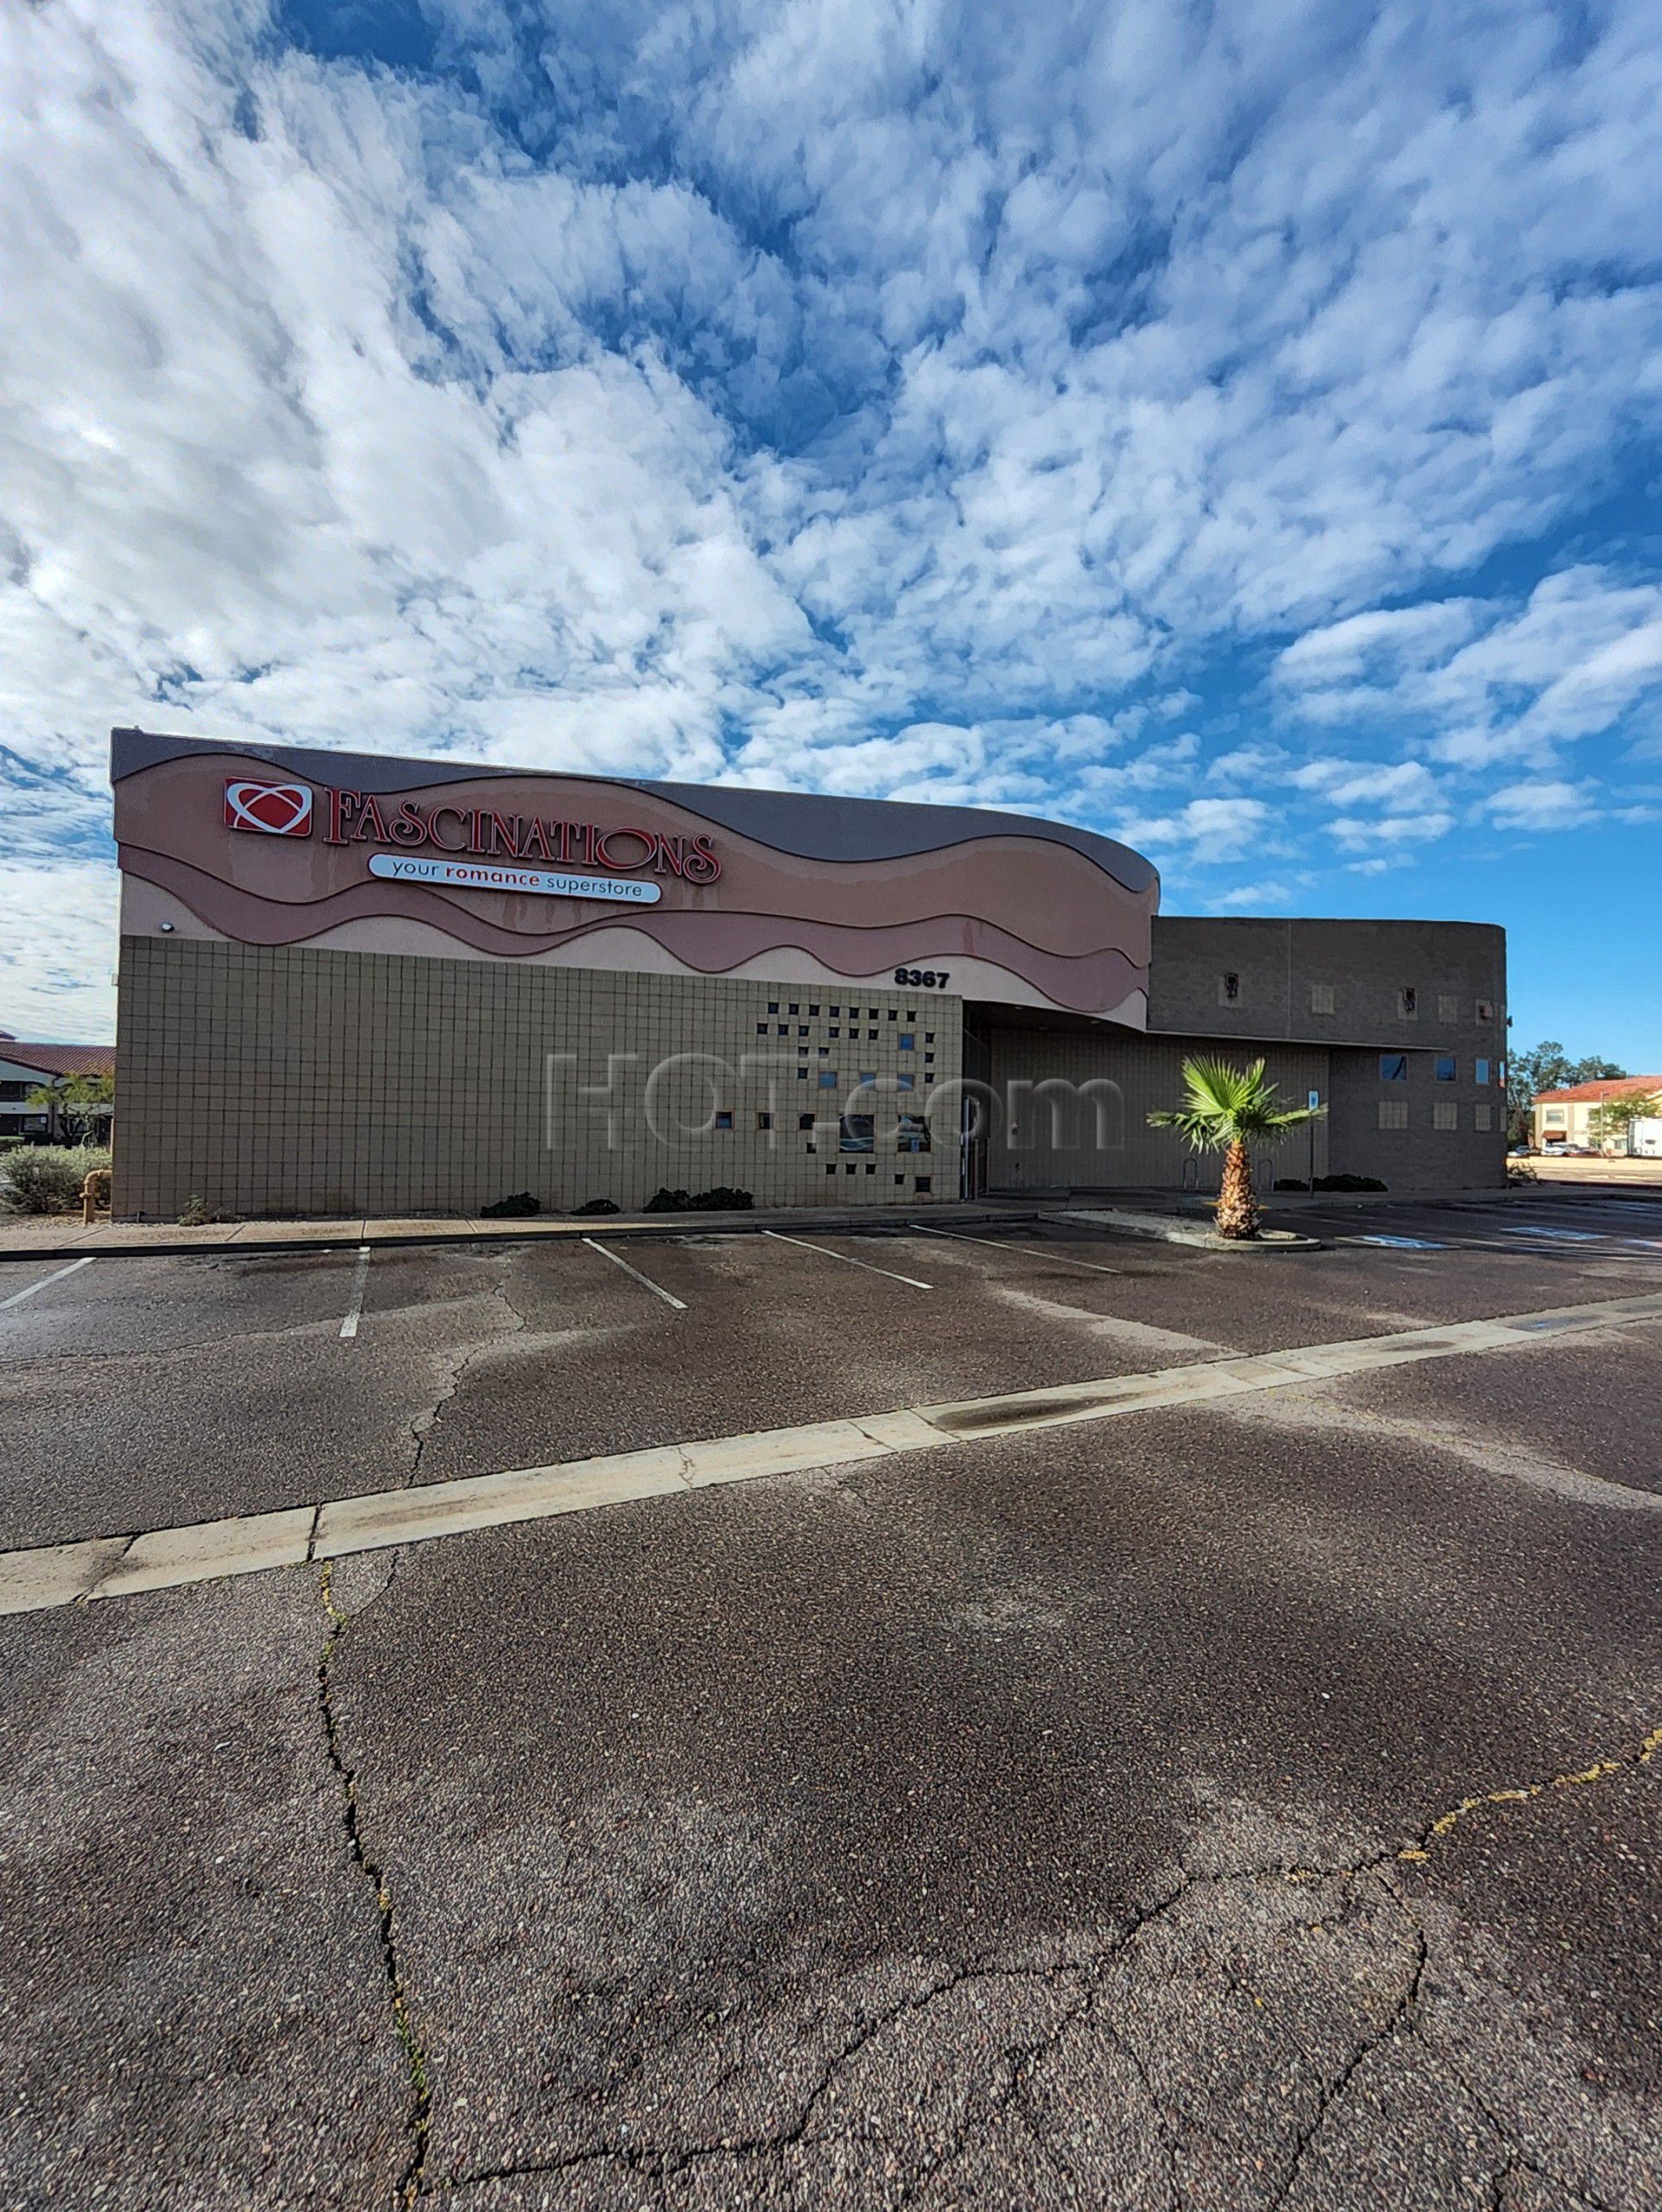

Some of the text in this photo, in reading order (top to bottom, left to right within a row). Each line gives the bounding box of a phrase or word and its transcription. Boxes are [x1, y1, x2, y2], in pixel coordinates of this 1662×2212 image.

[324, 786, 722, 884] FASCINATIONS
[392, 860, 643, 897] your romance superstore
[895, 968, 950, 988] 8367
